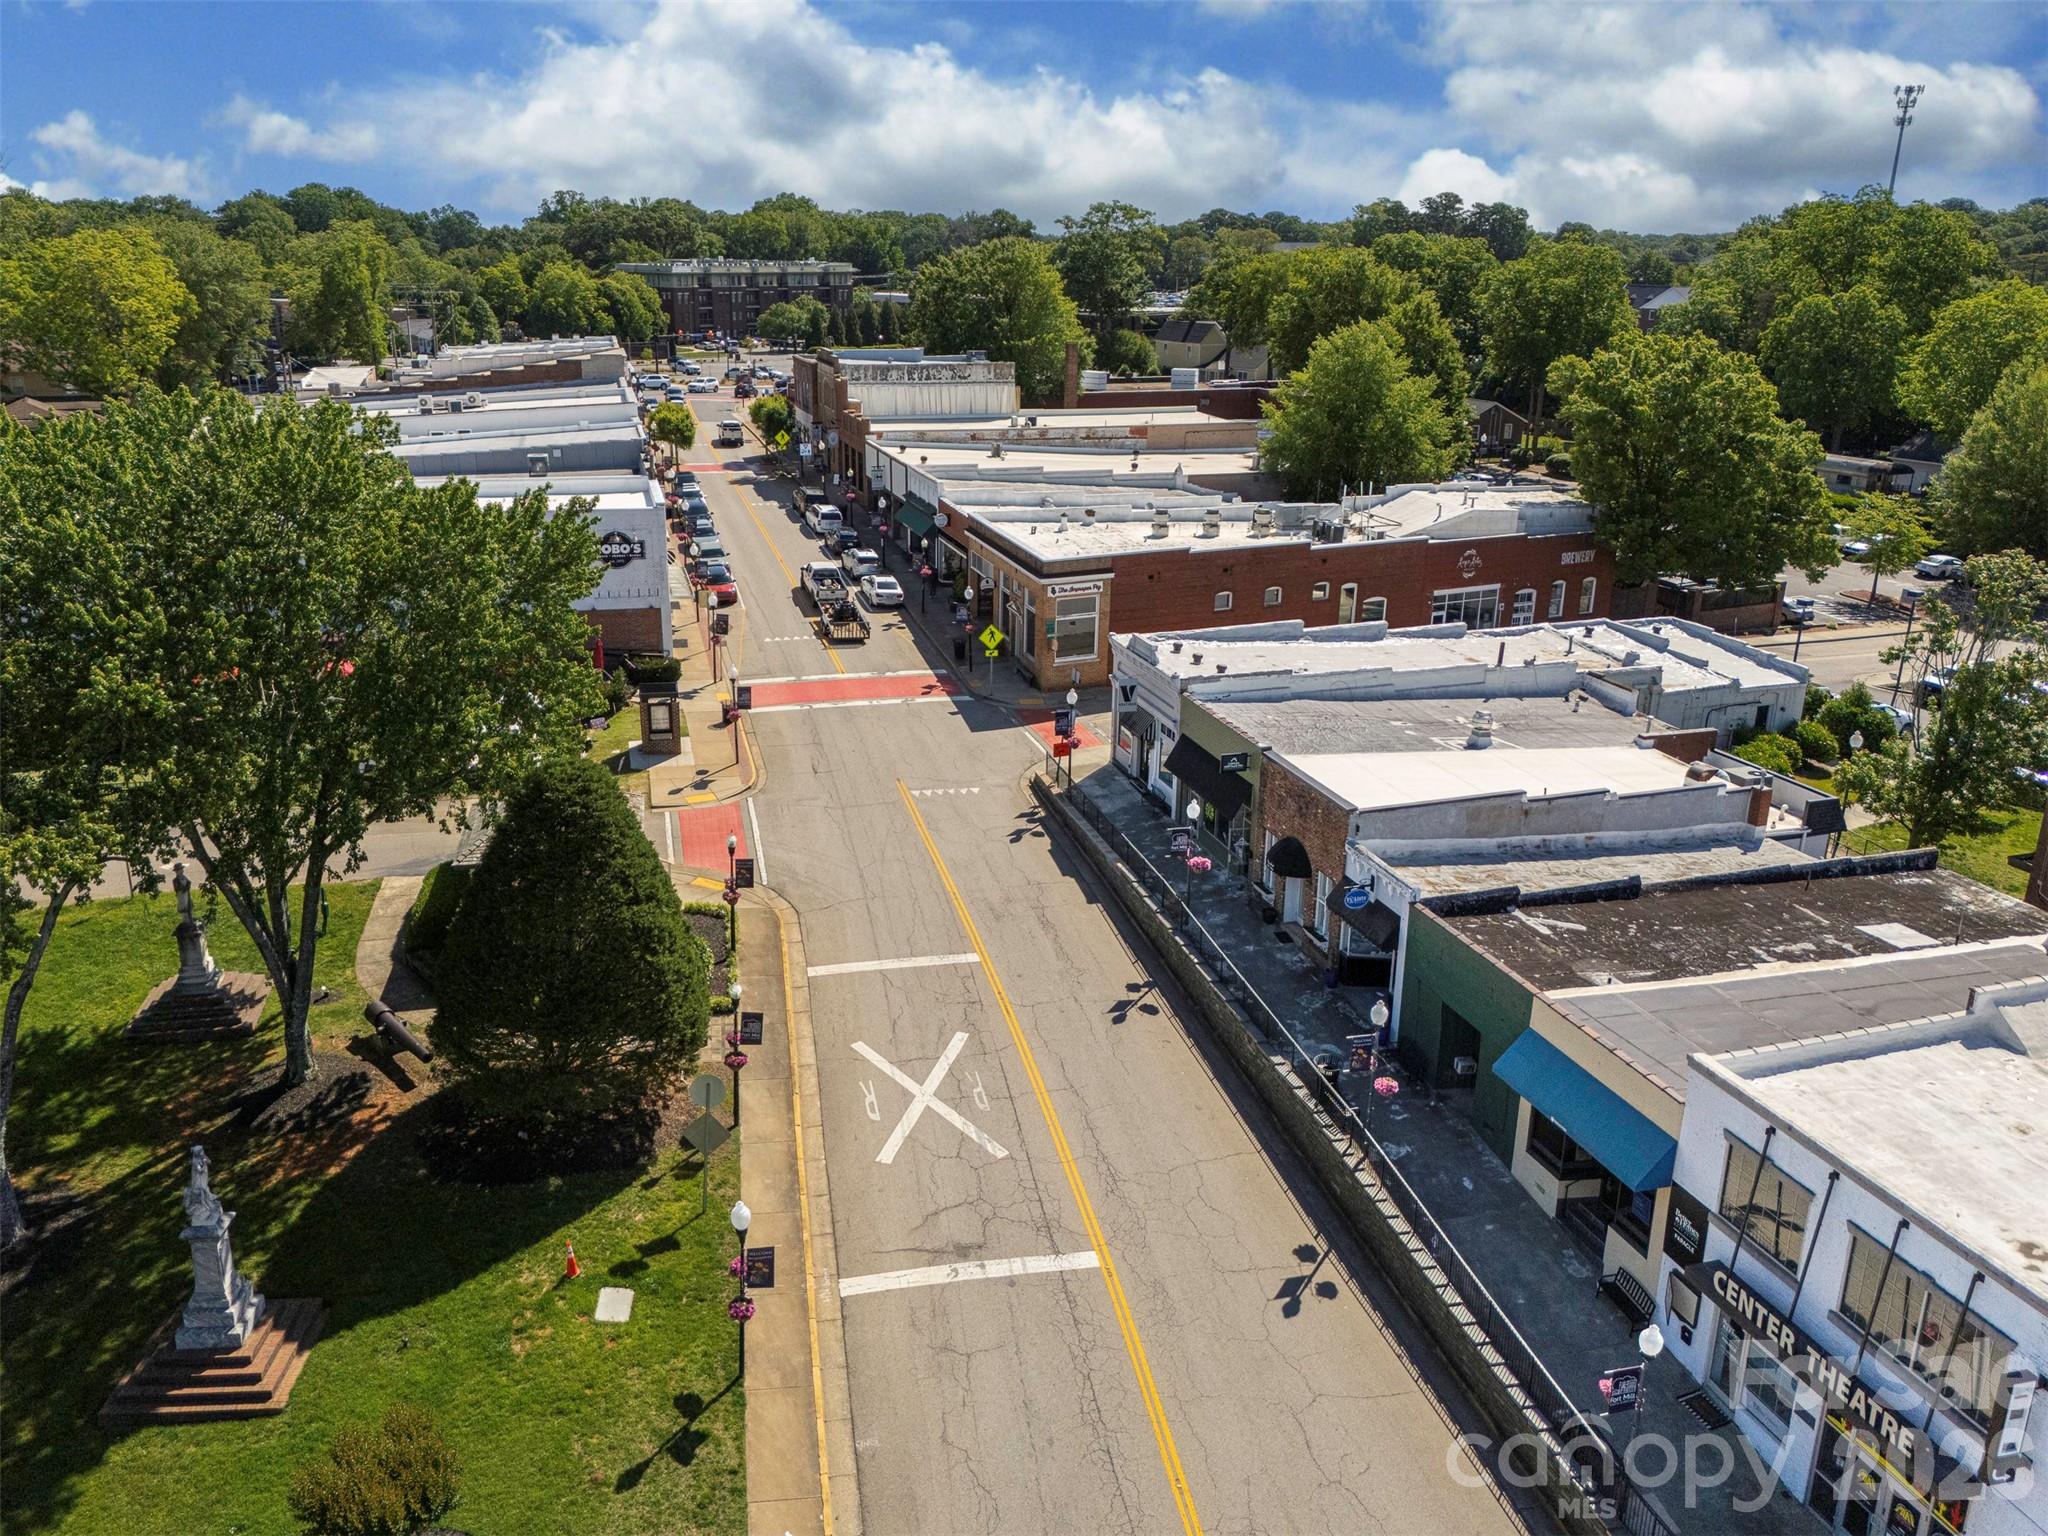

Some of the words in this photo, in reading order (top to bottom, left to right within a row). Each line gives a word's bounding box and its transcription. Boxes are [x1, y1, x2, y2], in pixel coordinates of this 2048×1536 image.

[599, 543, 641, 554] OBO'S
[1561, 550, 1596, 565] BREWERY
[1713, 1271, 1796, 1355] CENTER
[1806, 1345, 1915, 1458] THEATRE
